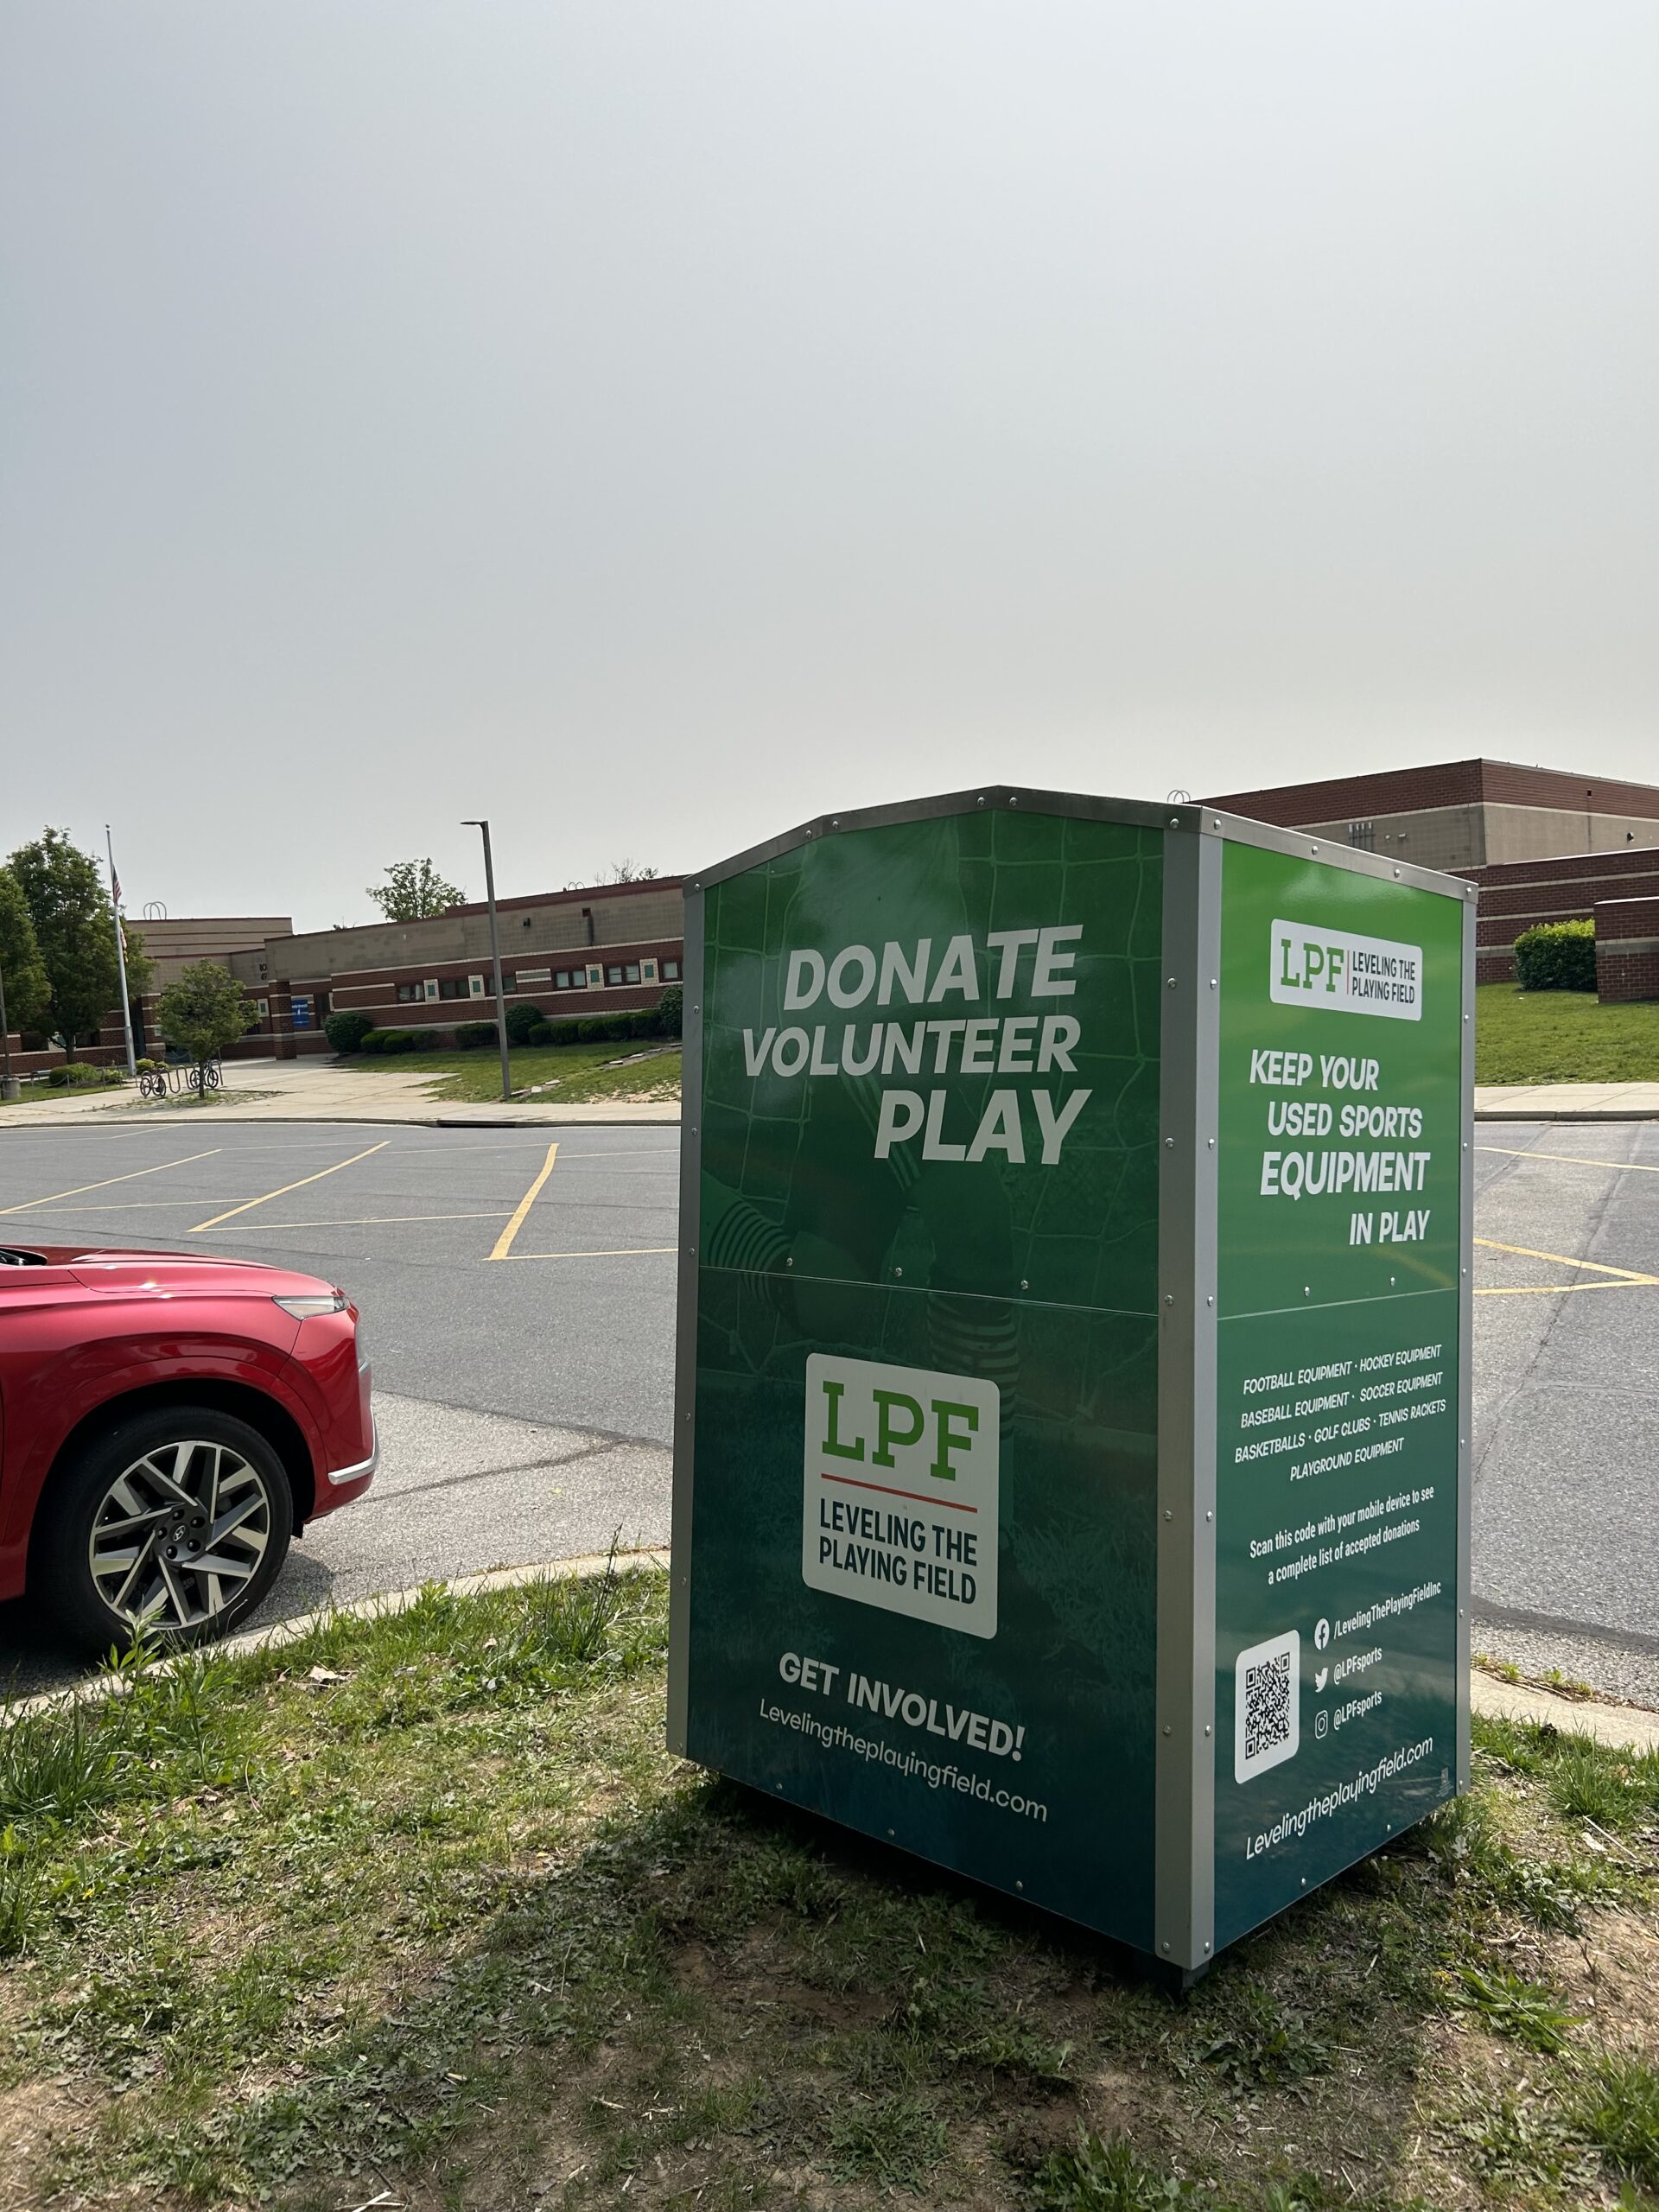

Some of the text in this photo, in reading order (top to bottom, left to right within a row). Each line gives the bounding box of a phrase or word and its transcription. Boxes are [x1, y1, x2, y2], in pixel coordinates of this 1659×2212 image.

[784, 924, 1084, 1011] DONATE
[1281, 938, 1344, 992] LPF
[1352, 951, 1415, 981] LEVELING THE
[1352, 976, 1414, 1004] PLAYING FIELD
[742, 1015, 1081, 1077] VOLUNTEER
[1249, 1049, 1379, 1091] KEEP YOUR
[874, 1089, 1093, 1165] PLAY
[1268, 1101, 1422, 1139] USED SPORTS
[1260, 1151, 1431, 1201] EQUIPMENT
[1349, 1210, 1431, 1246] IN PLAY
[1243, 1344, 1442, 1395] FOOTBALL EQUIPMENT HOCKEY EQUIPMENT
[1241, 1372, 1443, 1428] BASEBALL EQUIPMENT SOCCER EQUIPMENT
[822, 1381, 979, 1481] LPF
[1235, 1399, 1446, 1463] BASKETBALLS GOLF CLUBS TENNIS RACKETS
[1290, 1437, 1404, 1481] PLAYGROUND EQUIPMENT
[819, 1497, 978, 1567] LEVELING THE
[1249, 1486, 1434, 1559] Scan this code with your mobile device to see
[1268, 1518, 1420, 1585] a complete list of accepted donations
[819, 1535, 976, 1605] PLAYING FIELD
[1333, 1581, 1441, 1640] /LevelingThePlayingFieldInc
[1333, 1647, 1382, 1685] @LPFsports
[779, 1651, 1026, 1762] GET INVOLVED!
[1333, 1690, 1382, 1731] @LPFsports
[760, 1698, 1048, 1822] Levelingtheplayingfield.com
[1246, 1737, 1433, 1860] Levelingtheplayingfield.com
